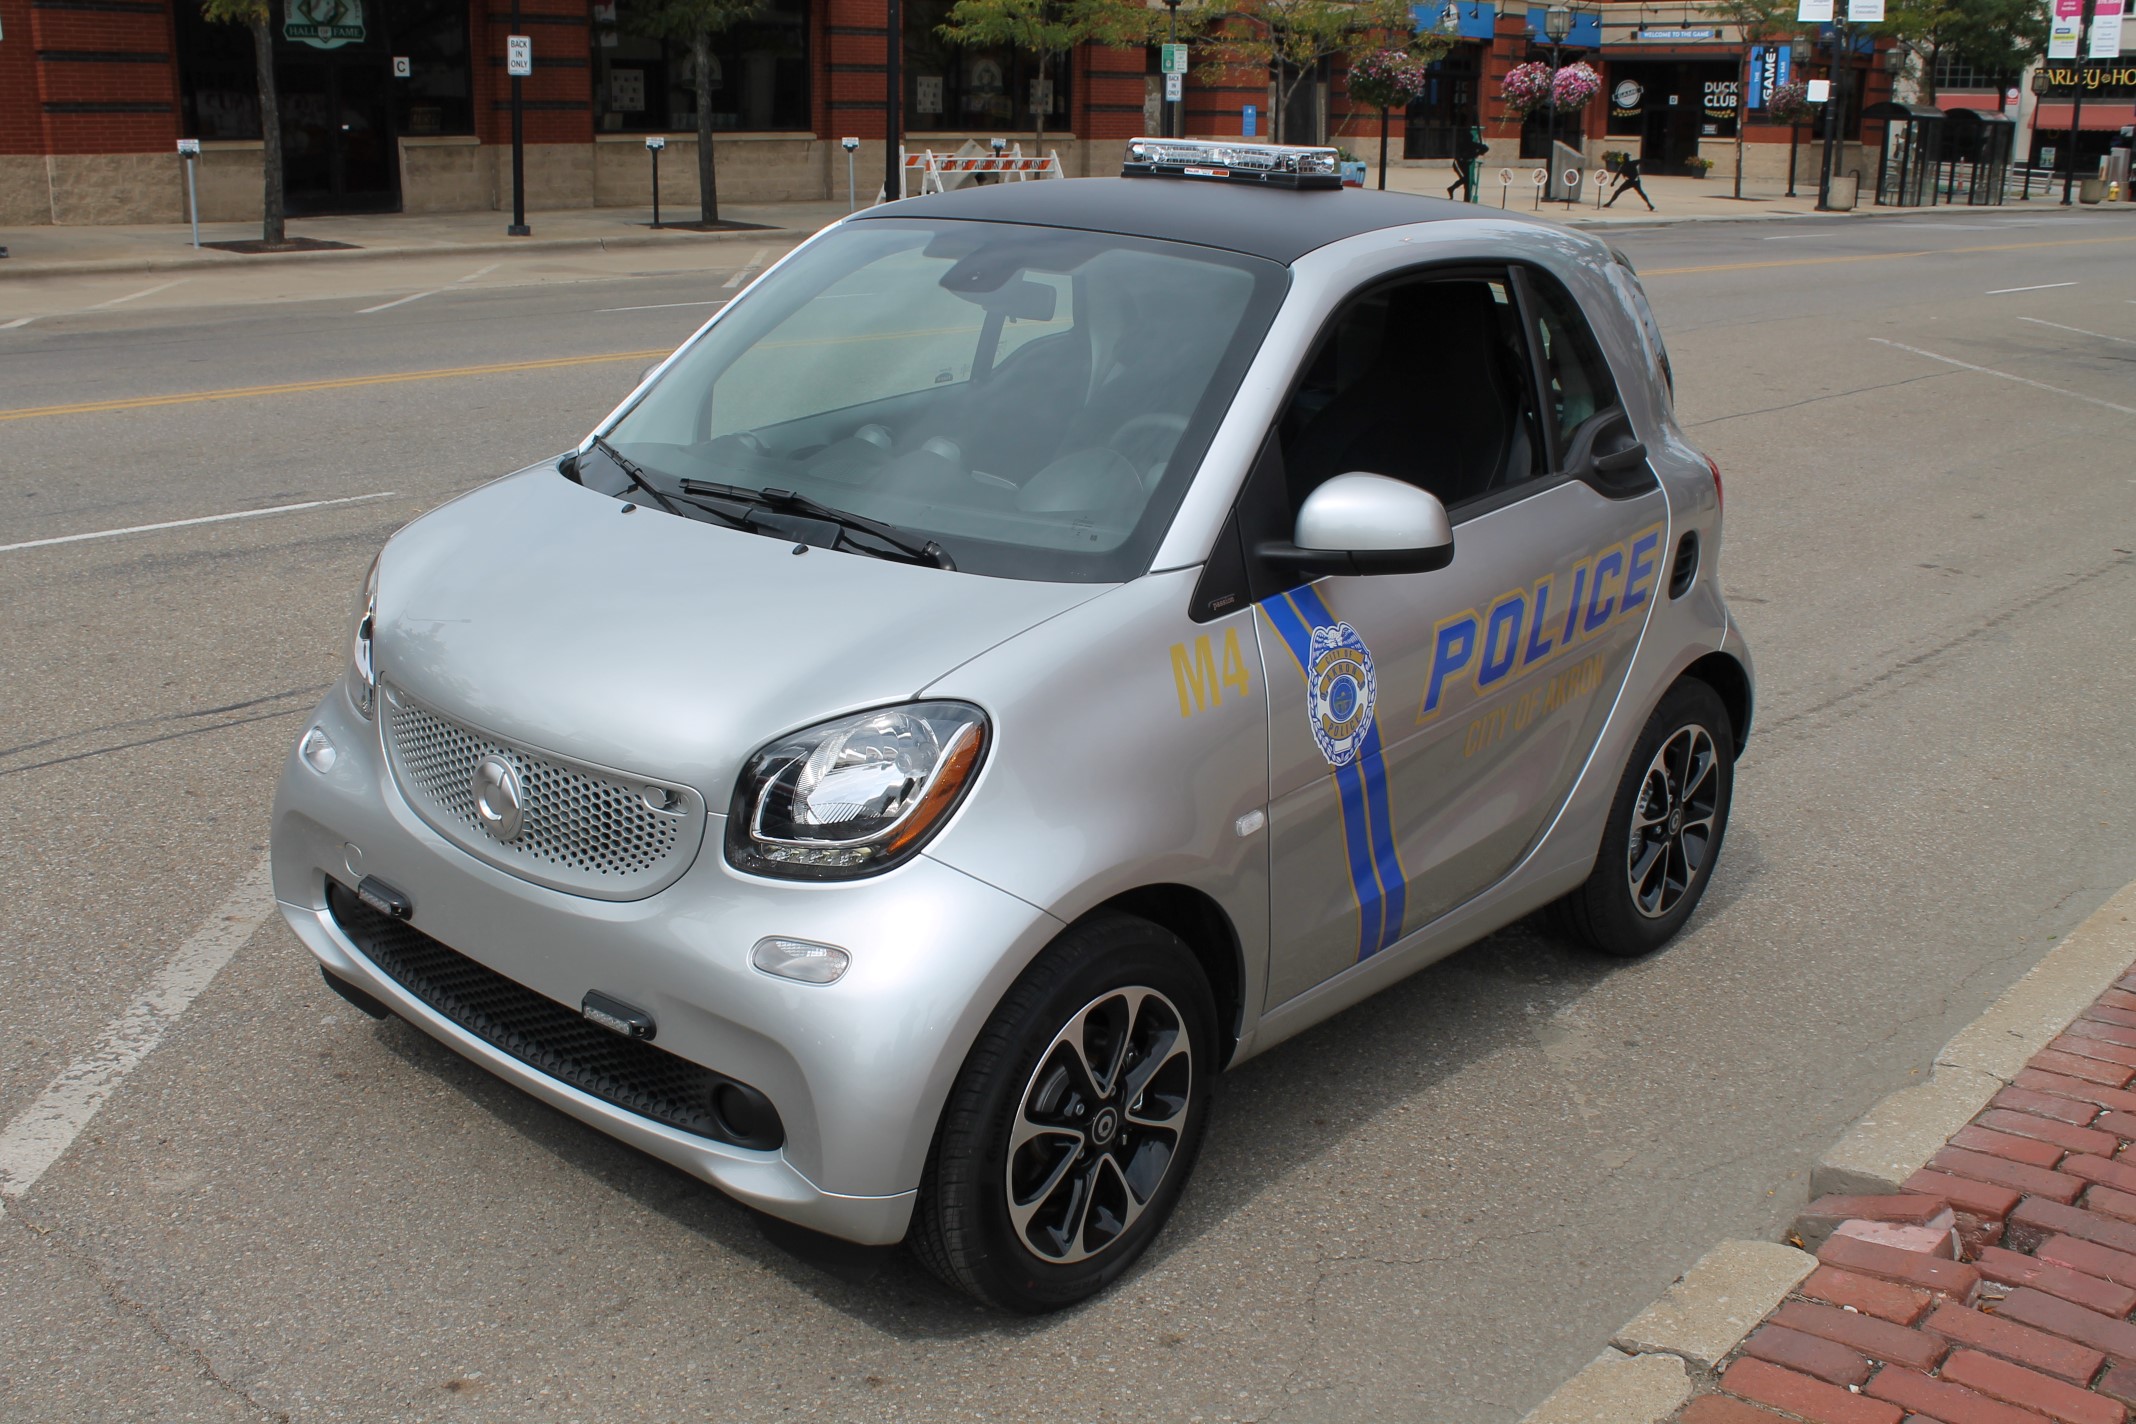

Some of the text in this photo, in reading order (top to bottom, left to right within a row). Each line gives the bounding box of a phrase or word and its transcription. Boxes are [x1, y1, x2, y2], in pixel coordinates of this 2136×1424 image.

[289, 26, 317, 36] HALL
[333, 27, 361, 37] FAME
[510, 40, 528, 49] BACK
[515, 50, 523, 58] IN
[396, 60, 406, 73] C
[510, 60, 528, 68] ONLY
[1762, 52, 1776, 101] GAME
[1704, 81, 1739, 93] DUCK
[1704, 95, 1737, 107] CLUB
[1212, 596, 1235, 611] passion
[1415, 521, 1664, 726] POLICE
[1324, 650, 1353, 664] CITY OF
[1169, 627, 1250, 719] M4
[1326, 662, 1358, 684] AKRON
[1463, 651, 1607, 758] CITY OF AKRON
[1327, 714, 1361, 738] POLICE
